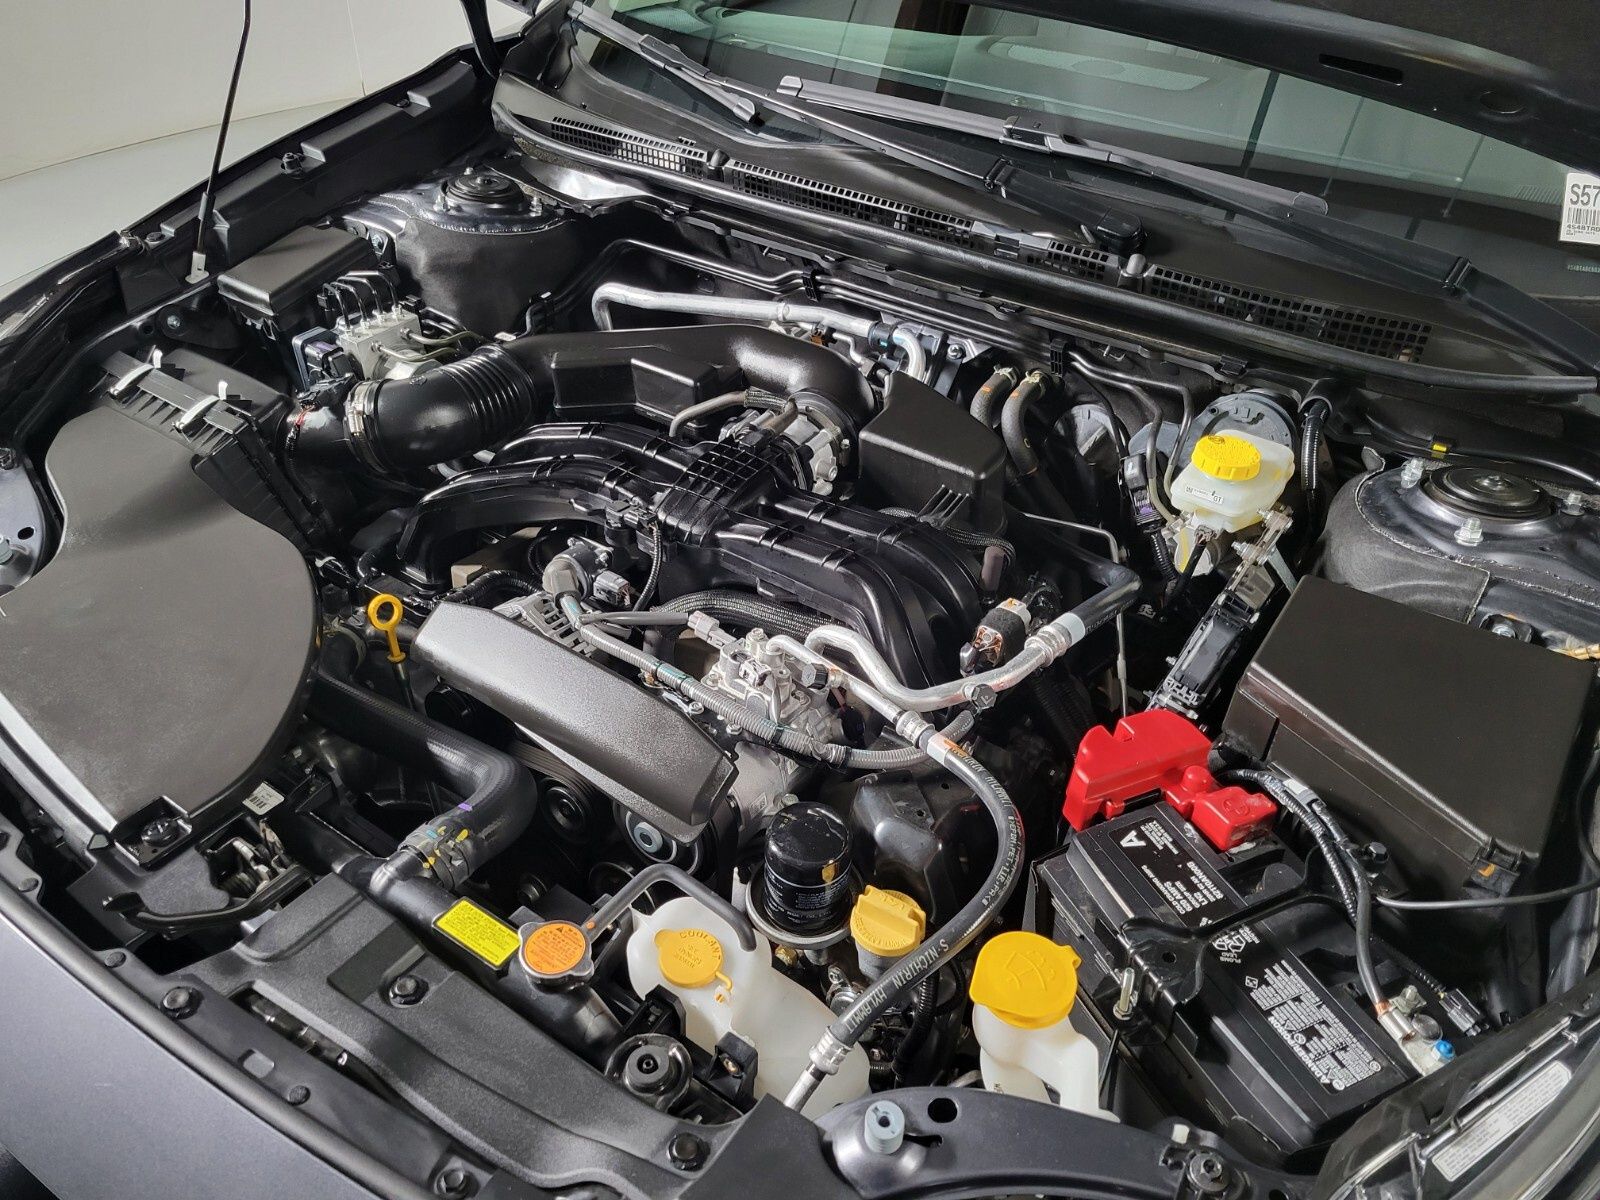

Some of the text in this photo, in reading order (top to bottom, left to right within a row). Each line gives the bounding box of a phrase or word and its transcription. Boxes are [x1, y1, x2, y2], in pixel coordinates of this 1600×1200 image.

[1119, 830, 1147, 848] A
[1151, 877, 1174, 901] CRANKING
[1163, 880, 1183, 899] AMPS
[1171, 900, 1185, 914] COLD
[1183, 890, 1200, 908] GROUP
[1267, 1015, 1324, 1077] DANGER/POISON
